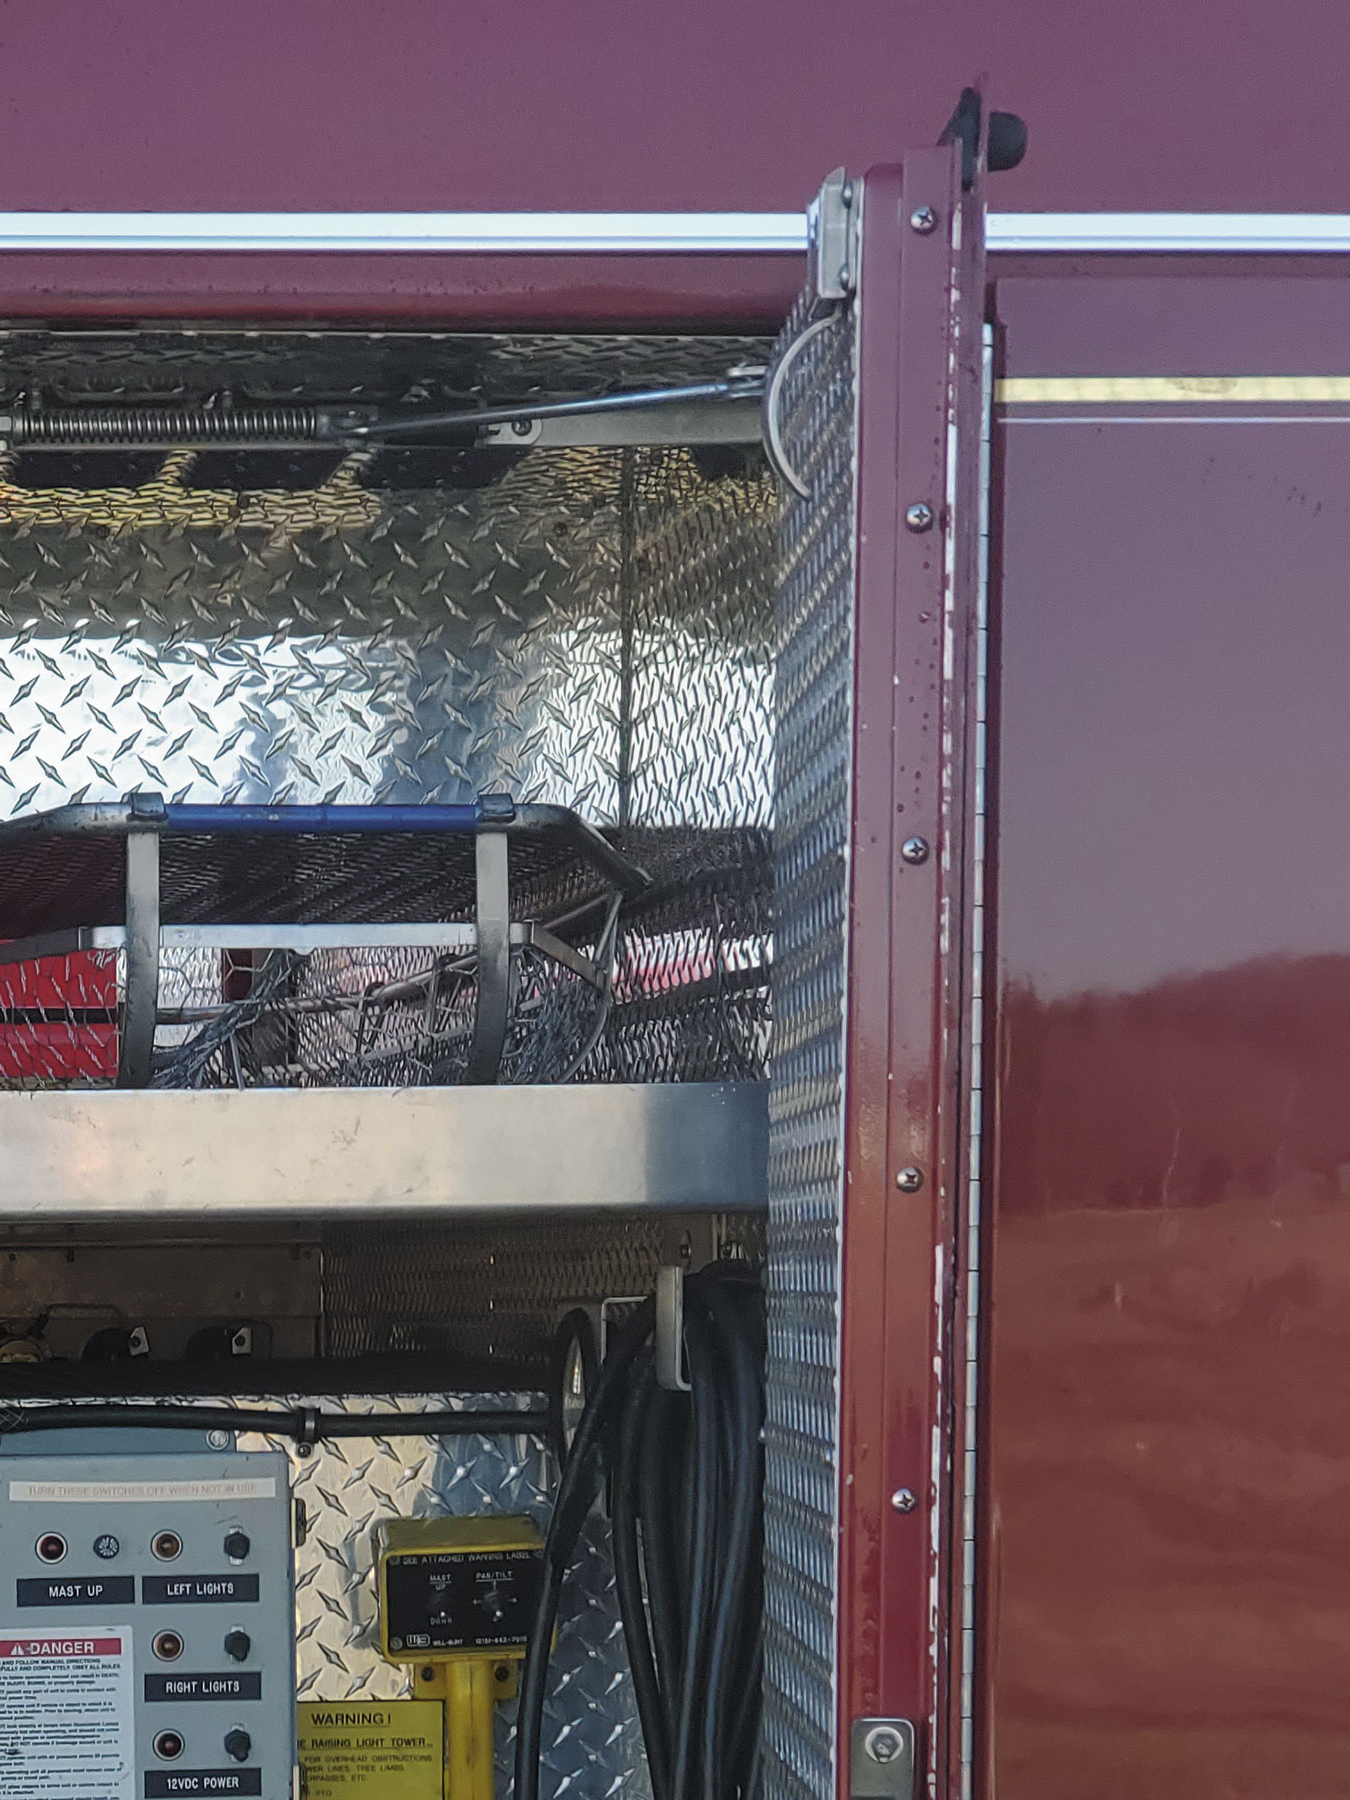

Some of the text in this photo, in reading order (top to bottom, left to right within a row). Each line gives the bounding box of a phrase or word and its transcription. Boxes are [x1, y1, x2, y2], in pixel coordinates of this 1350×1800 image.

[28, 1483, 258, 1496] TURN THESE SWITCHES OFF WHEN NOT IN USE
[422, 1555, 464, 1564] ATTACHED
[468, 1553, 503, 1562] WARNING
[506, 1552, 531, 1560] LABEL
[476, 1571, 512, 1579] PAN/TILT
[49, 1585, 104, 1598] MAST UP
[167, 1582, 234, 1596] LEFT LIGHTS
[30, 1641, 94, 1655] DANGER
[166, 1680, 240, 1693] RIGHT LIGHTS
[311, 1738, 351, 1748] RAISING
[356, 1738, 385, 1748] LIGHT
[325, 1755, 367, 1763] OVERHEAD
[372, 1754, 432, 1762] OBSTRUCTIONS
[356, 1764, 376, 1772] TREE
[166, 1776, 239, 1790] 12VDC POWER
